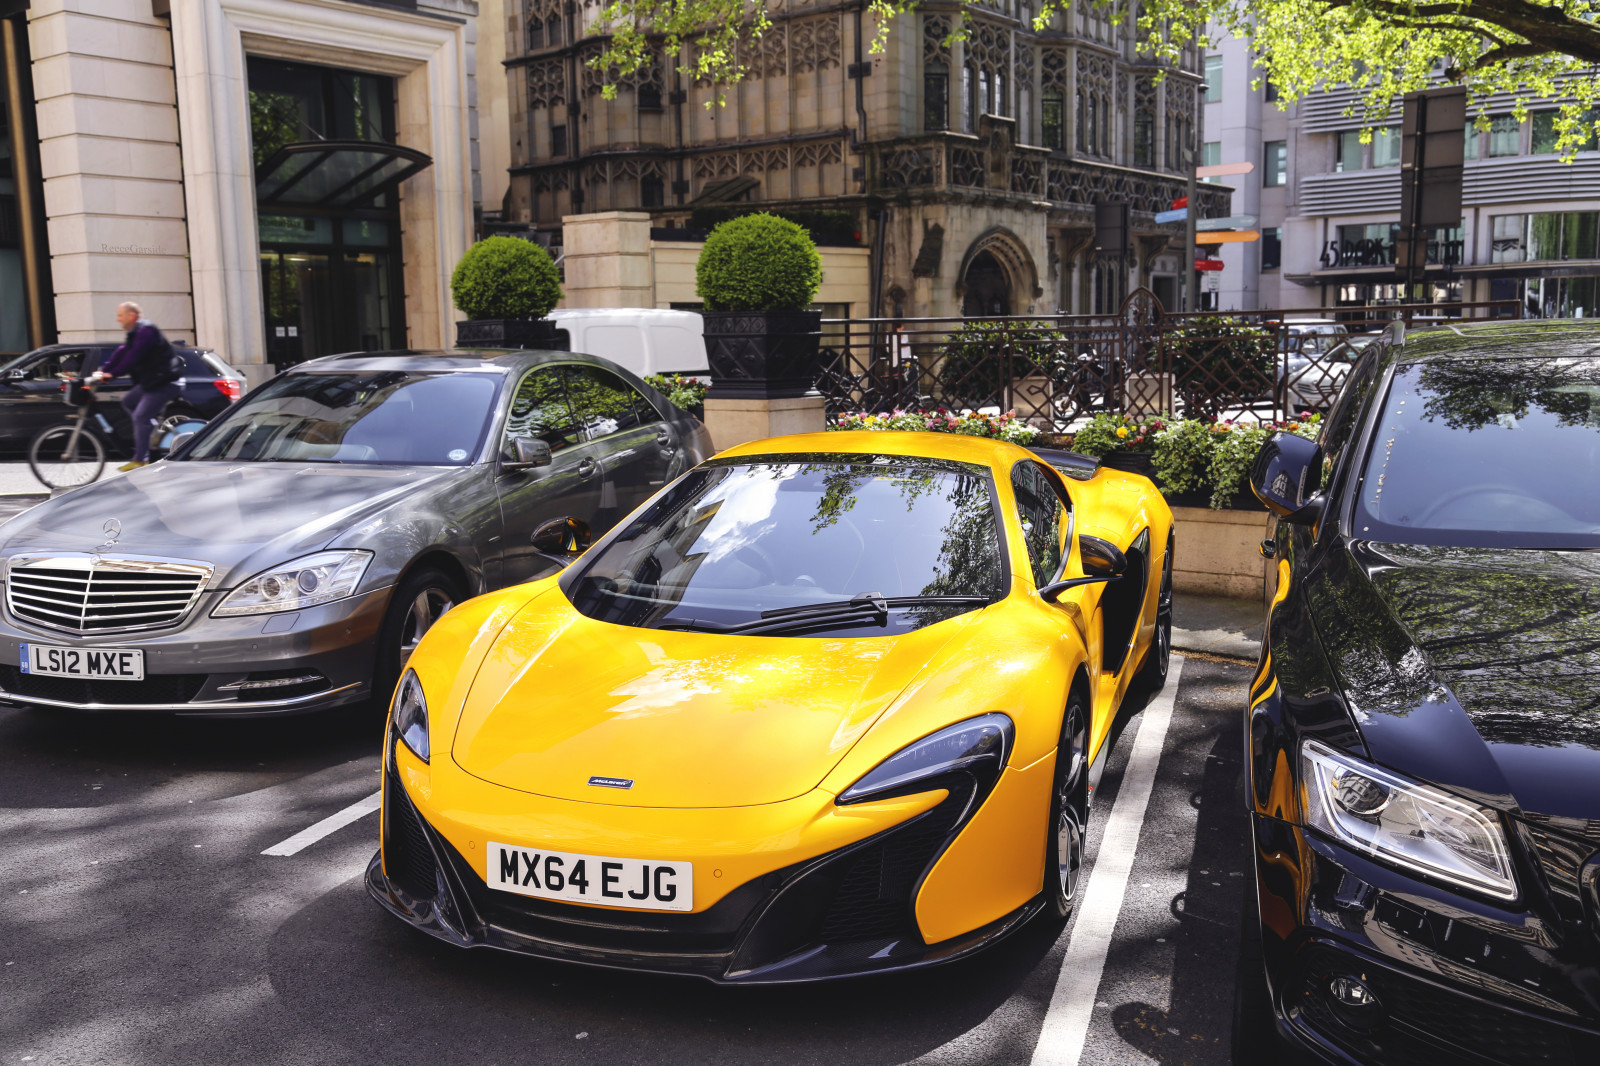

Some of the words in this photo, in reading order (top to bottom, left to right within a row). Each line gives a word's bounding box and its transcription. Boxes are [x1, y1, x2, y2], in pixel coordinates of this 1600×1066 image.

[1319, 240, 1340, 268] 45
[35, 647, 81, 674] LS12
[87, 651, 134, 676] MXE
[499, 847, 589, 895] MX64
[601, 861, 678, 902] EJG
